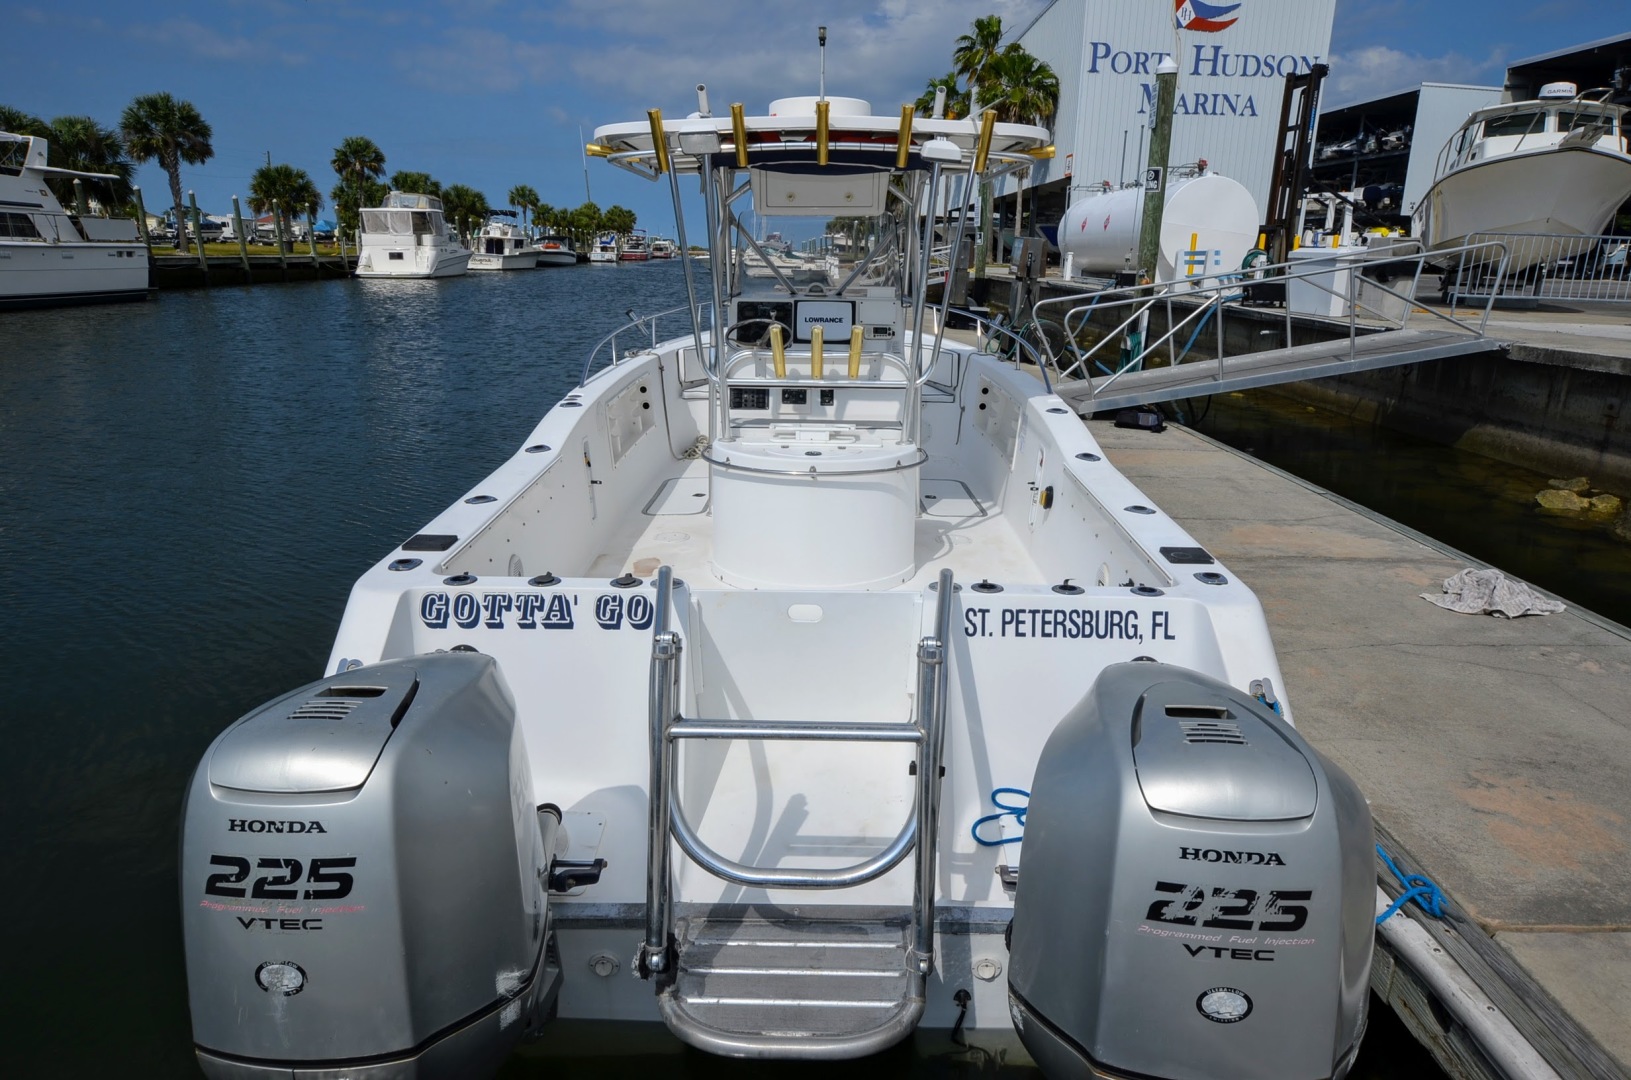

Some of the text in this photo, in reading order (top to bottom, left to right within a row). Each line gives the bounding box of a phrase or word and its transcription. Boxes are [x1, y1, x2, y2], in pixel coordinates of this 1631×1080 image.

[593, 592, 655, 631] GO
[964, 607, 1176, 645] ST. PETERSBURG, FL
[228, 818, 328, 834] HONDA
[1179, 846, 1287, 867] HONDA
[204, 854, 358, 901] 225
[1145, 880, 1313, 932] 225
[236, 916, 323, 931] VTEC
[1137, 924, 1315, 947] Programmed Fuel Injection
[1182, 943, 1276, 962] VTEC
